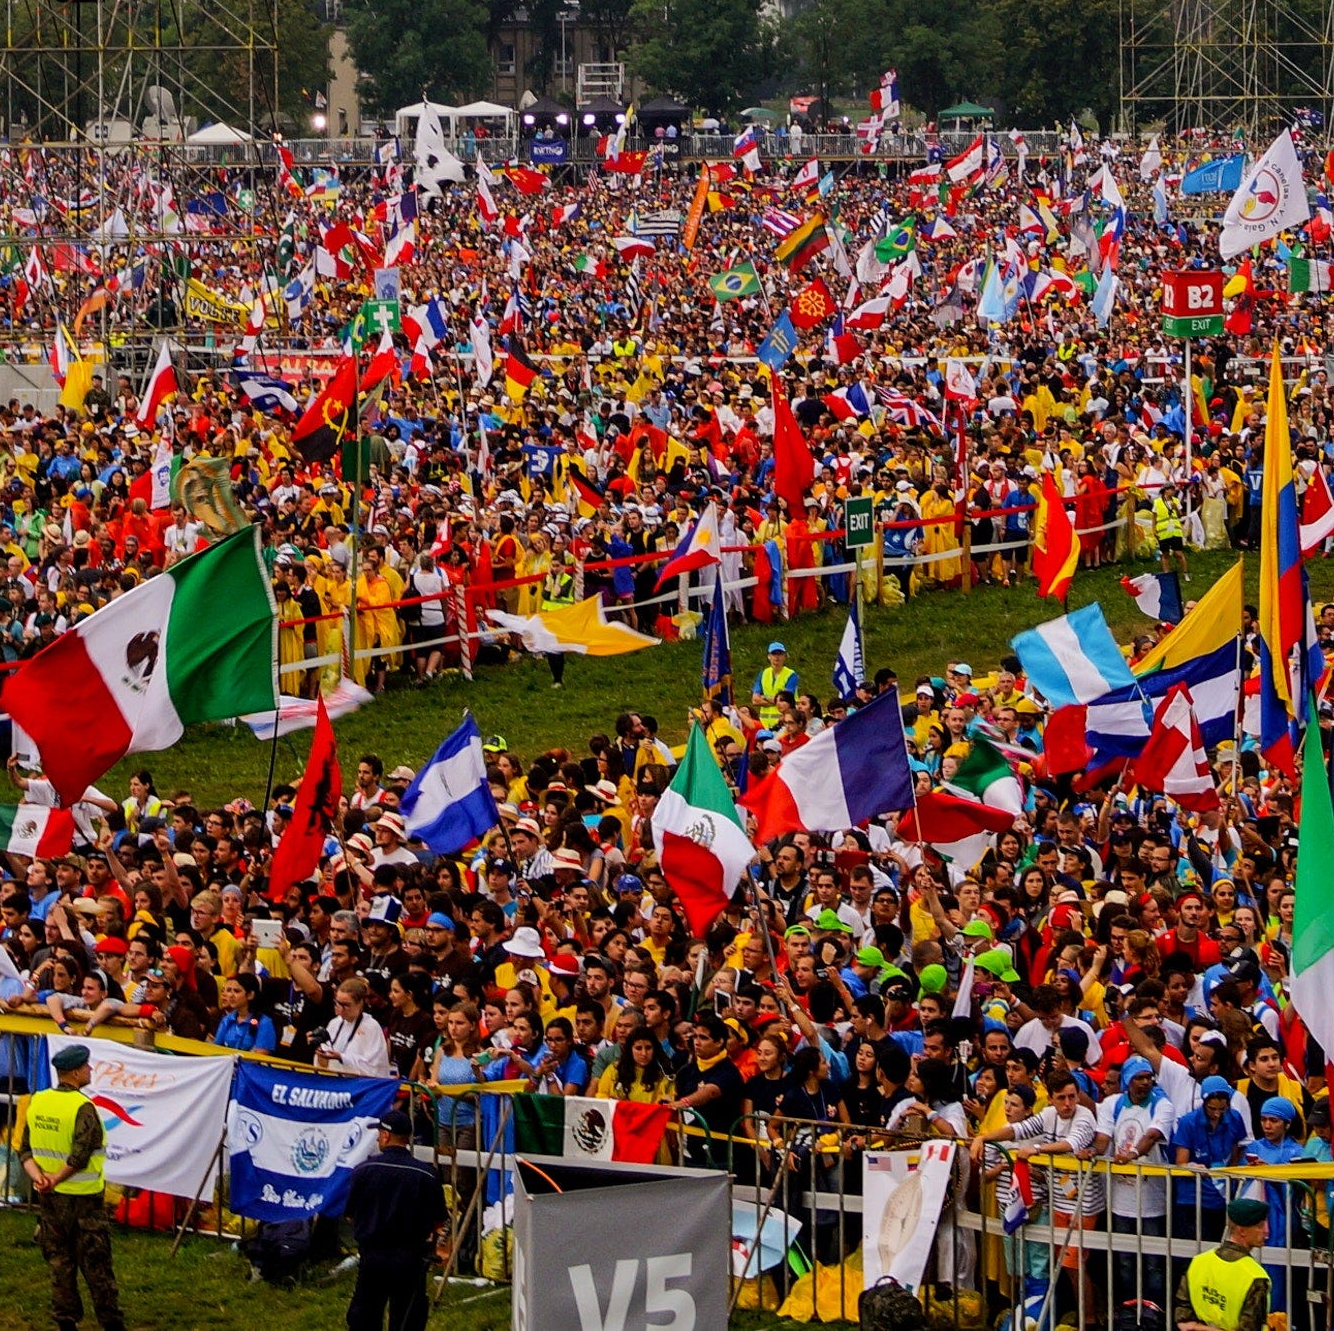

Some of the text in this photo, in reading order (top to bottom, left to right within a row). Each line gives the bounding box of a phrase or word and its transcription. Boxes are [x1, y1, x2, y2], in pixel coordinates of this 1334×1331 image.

[1187, 284, 1214, 309] B2
[1191, 318, 1211, 330] EXIT
[850, 512, 869, 531] EXIT
[271, 1083, 354, 1110] EL SALVADOR
[568, 1252, 697, 1331] V5
